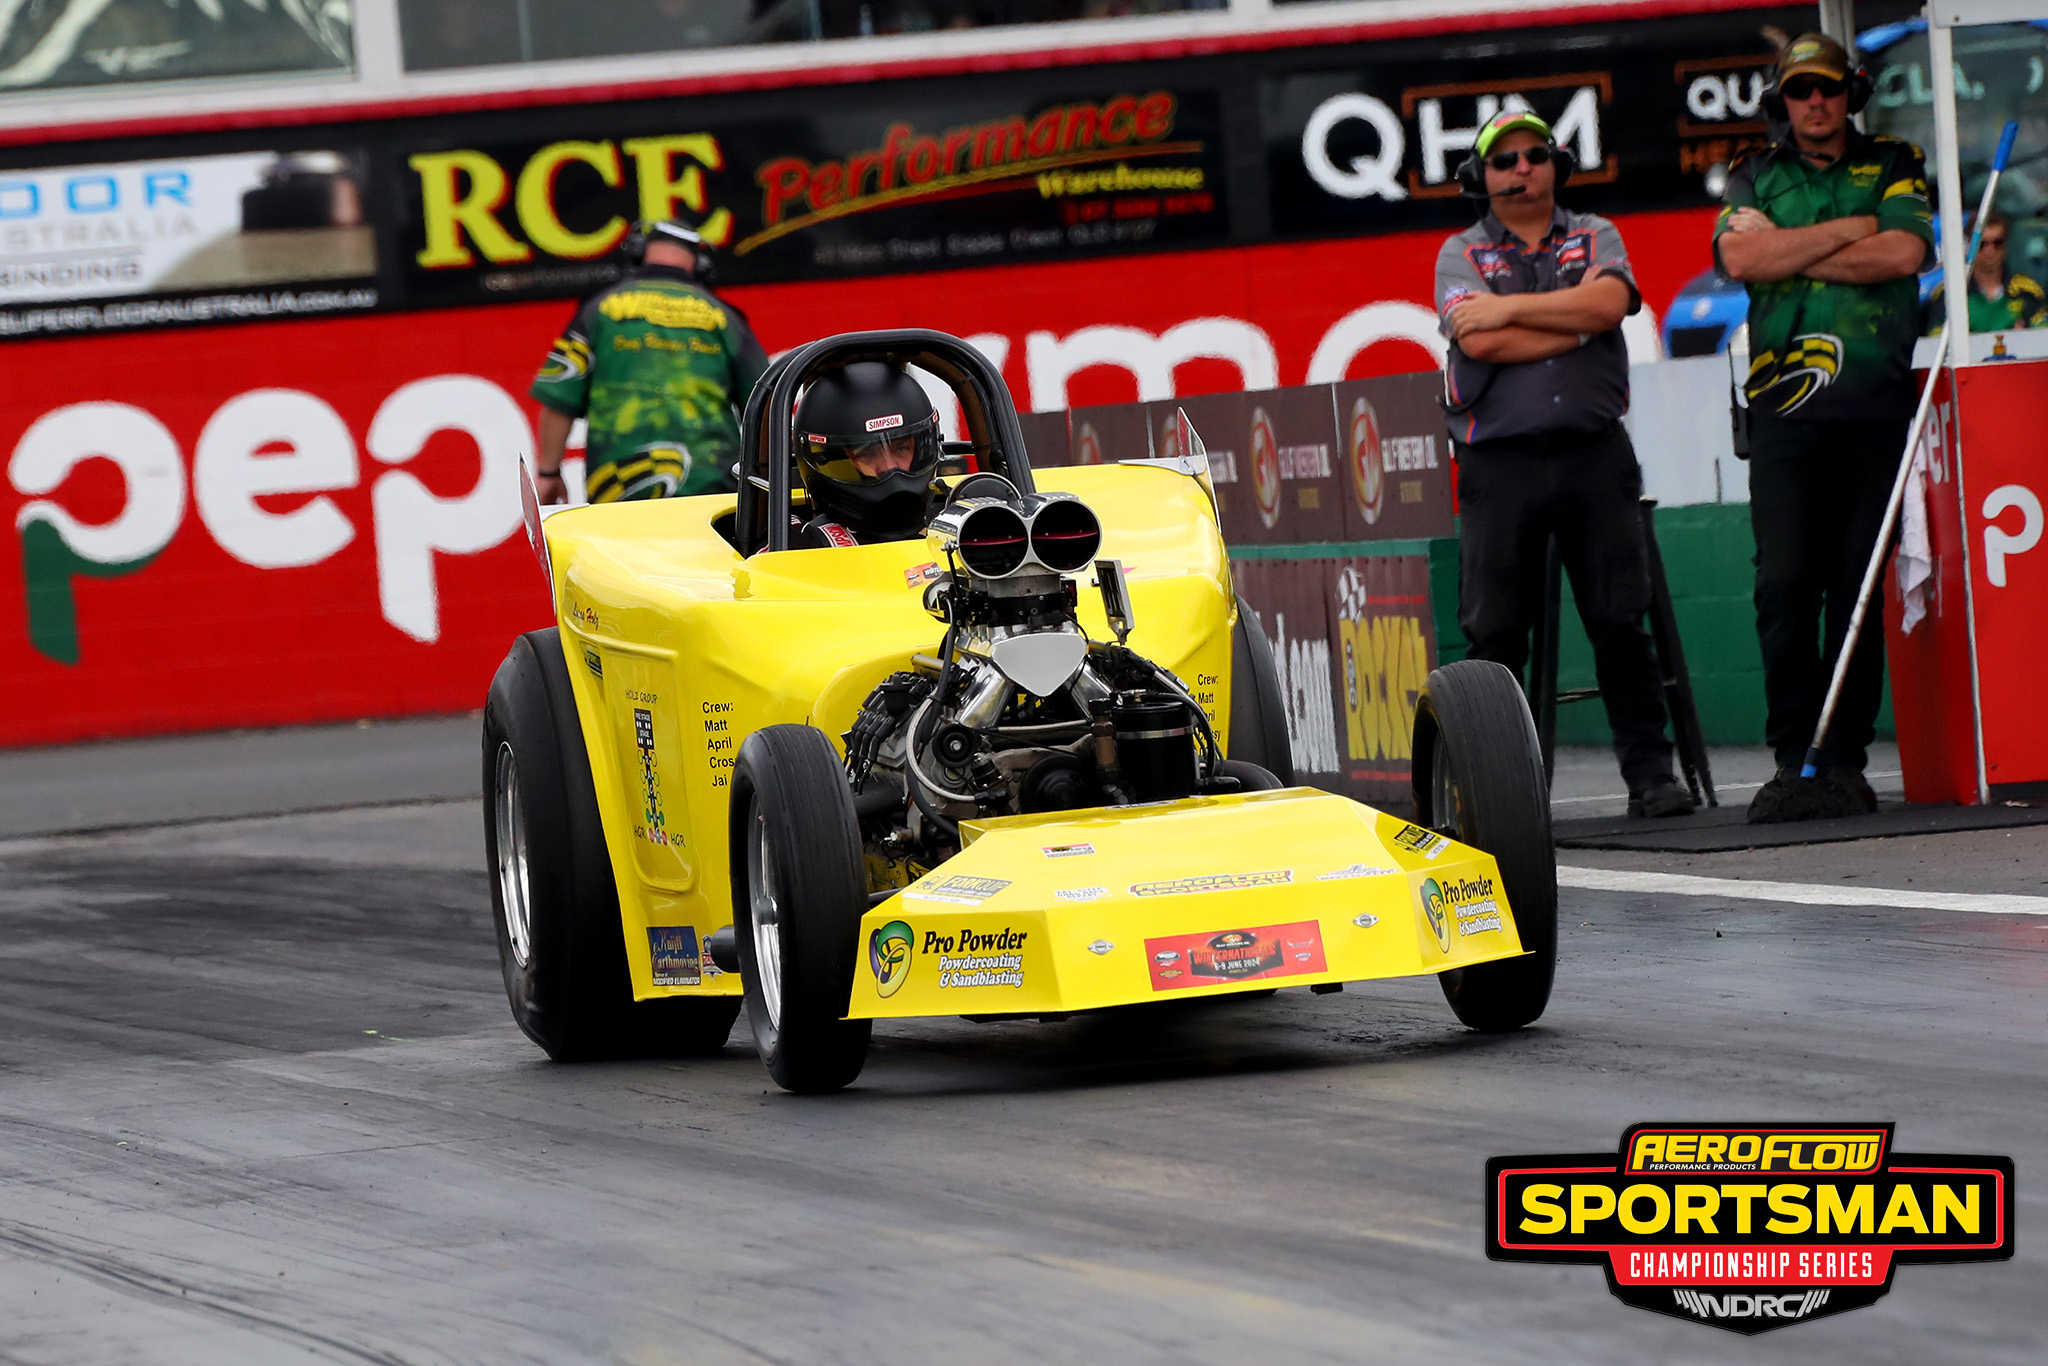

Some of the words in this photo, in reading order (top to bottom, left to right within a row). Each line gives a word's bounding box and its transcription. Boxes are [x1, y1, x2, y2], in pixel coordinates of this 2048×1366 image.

[1303, 87, 1601, 200] QHM
[758, 91, 1177, 226] Performance
[1037, 163, 1203, 198] Warehouse
[408, 132, 735, 268] RCE
[868, 417, 901, 430] SIMPSON
[1197, 674, 1219, 686] Crew:
[1339, 616, 1428, 760] ROCKET
[702, 702, 734, 714] Crew:
[1198, 693, 1214, 704] Matt
[704, 719, 728, 732] Matt
[707, 736, 733, 752] April
[712, 774, 728, 787] Jai
[945, 876, 1011, 894] FORKQUIP
[1135, 871, 1287, 892] AEROFLOW
[1138, 876, 1292, 896] SPORTSMAN
[1442, 881, 1461, 904] Pro
[1459, 874, 1493, 902] Powder
[1454, 898, 1498, 920] Powdercoating
[1458, 921, 1466, 936] &
[1465, 915, 1502, 936] Sandblasting
[922, 931, 955, 954] Pro
[957, 927, 1028, 952] Powder
[652, 952, 699, 973] Earthmoving
[938, 952, 1024, 972] Powdercoating
[1226, 959, 1243, 970] JUNE
[1243, 957, 1260, 968] 2024
[939, 974, 950, 988] &
[951, 969, 1024, 988] Sandblasting
